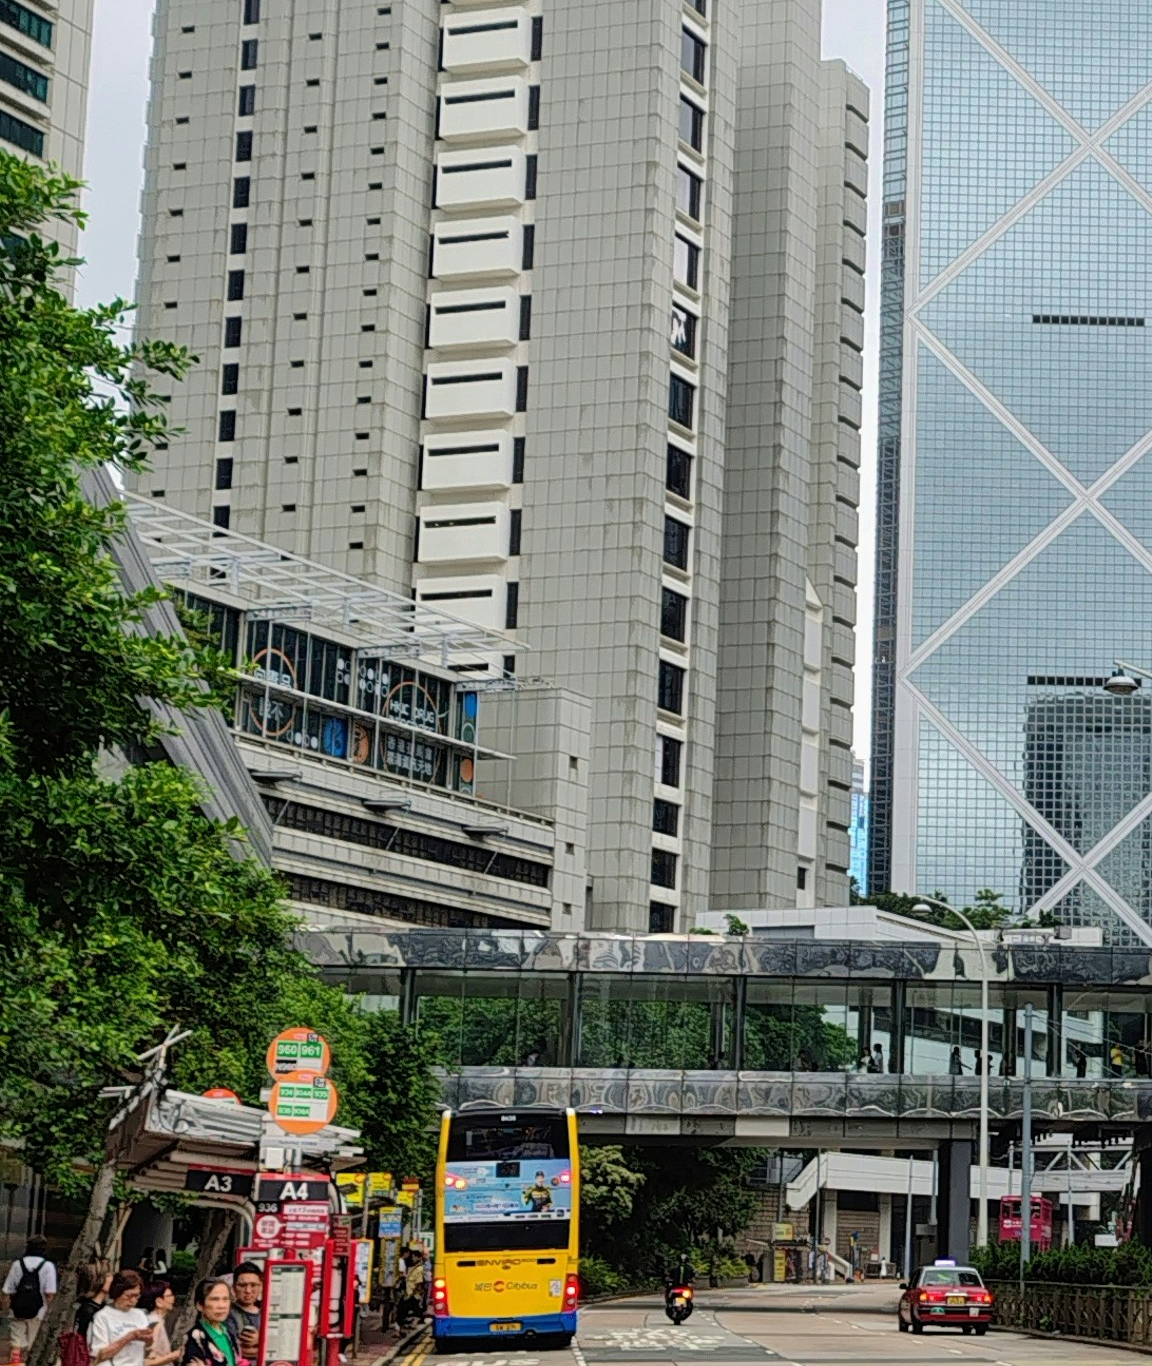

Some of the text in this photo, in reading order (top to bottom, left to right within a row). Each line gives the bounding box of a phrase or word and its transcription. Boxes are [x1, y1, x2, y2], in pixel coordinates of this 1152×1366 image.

[413, 706, 435, 724] DRUG
[278, 1044, 321, 1056] 960 961
[204, 1174, 233, 1193] A3
[279, 1181, 309, 1201] A4
[257, 1202, 278, 1213] 936
[506, 1281, 538, 1292] Citybus
